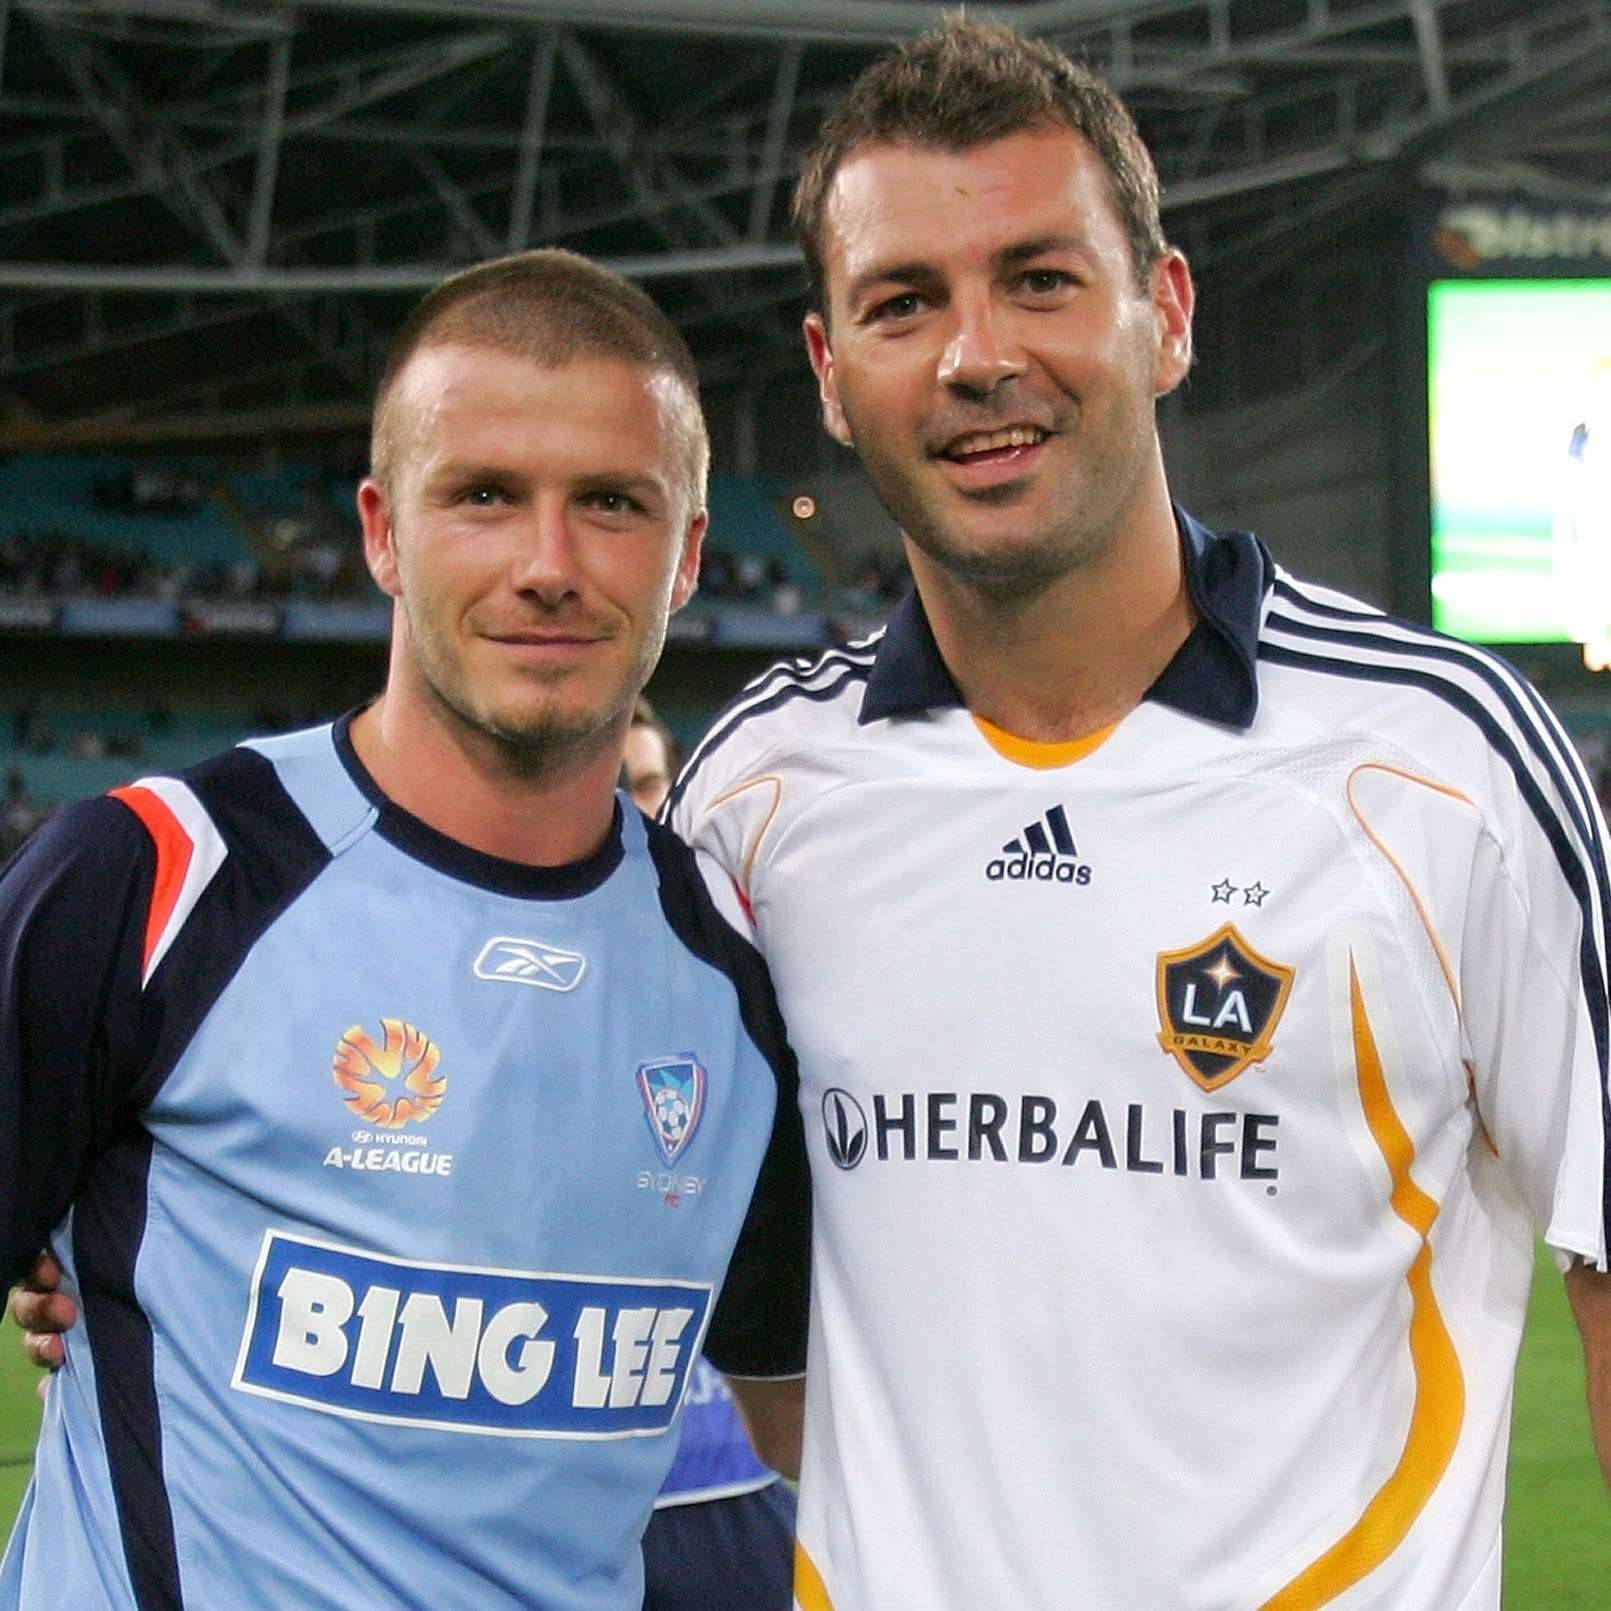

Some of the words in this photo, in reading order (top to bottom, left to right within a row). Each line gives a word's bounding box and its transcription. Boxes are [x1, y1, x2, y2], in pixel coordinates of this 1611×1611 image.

[986, 852, 1092, 885] adidas
[1183, 983, 1253, 1033] LA
[1172, 1032, 1252, 1055] GALAXY
[375, 1132, 428, 1146] HYUNDAI
[873, 1093, 1279, 1180] HERBALIFE
[323, 1147, 453, 1176] A-LEAGUE
[272, 1267, 556, 1406] BING
[572, 1306, 694, 1408] LEE
